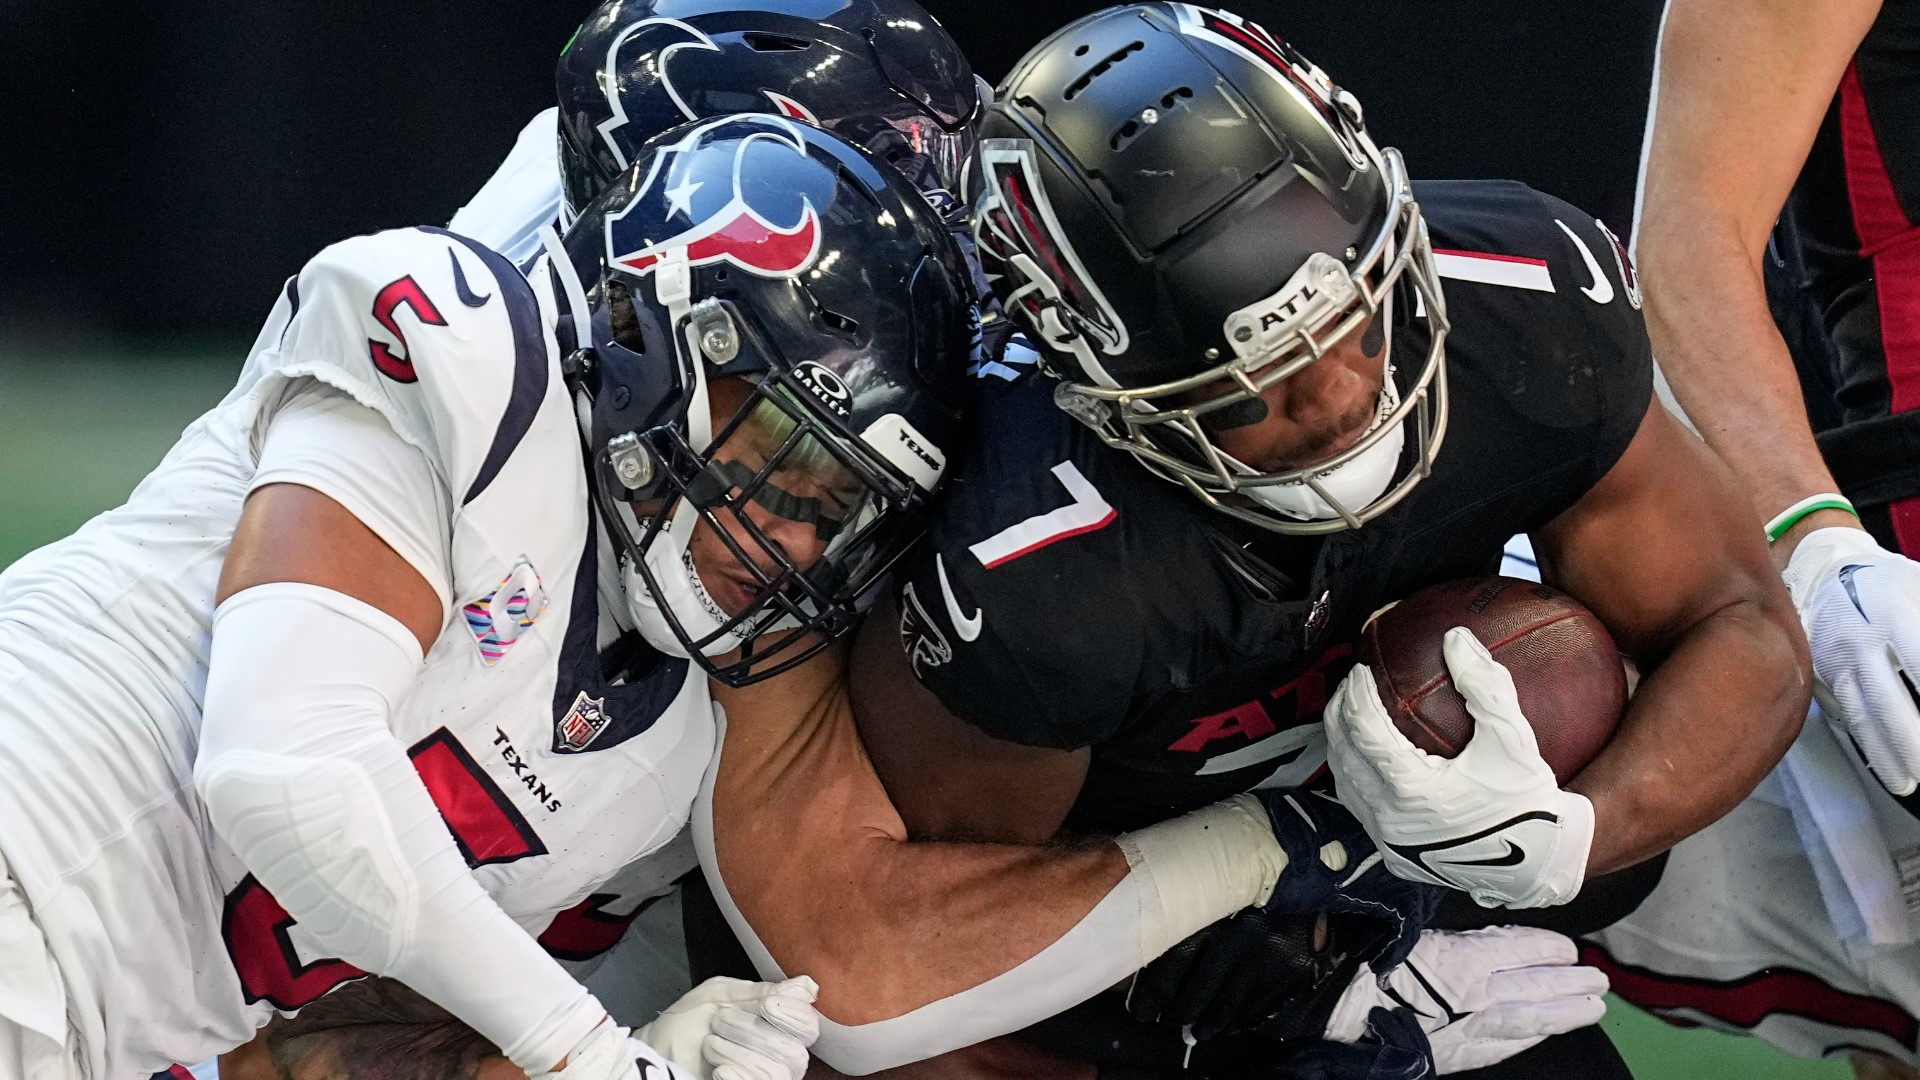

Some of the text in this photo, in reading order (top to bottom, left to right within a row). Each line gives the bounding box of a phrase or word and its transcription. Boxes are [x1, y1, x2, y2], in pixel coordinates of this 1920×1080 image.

[368, 273, 449, 384] 5
[1259, 284, 1319, 332] ATL
[793, 368, 847, 416] OAKLEY
[968, 459, 1119, 570] 7
[564, 714, 593, 746] NFL
[1167, 642, 1353, 752] AT
[492, 724, 562, 813] TEXANS
